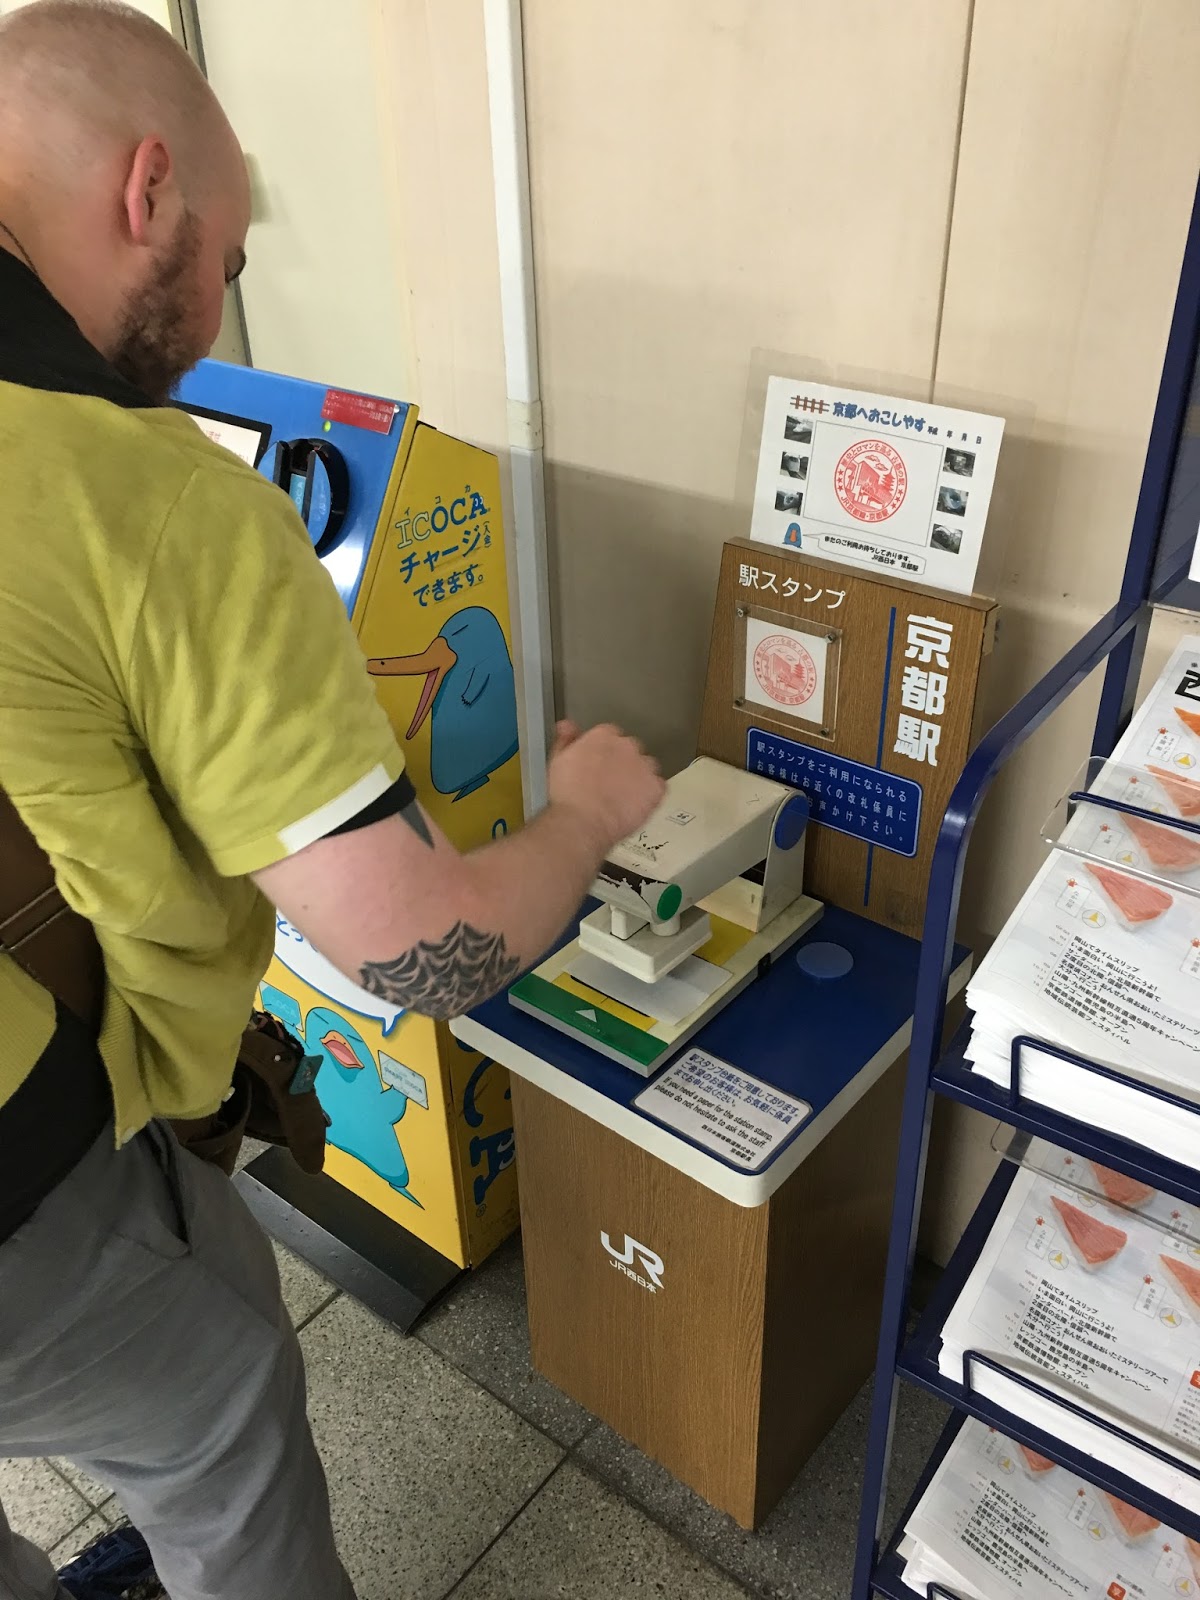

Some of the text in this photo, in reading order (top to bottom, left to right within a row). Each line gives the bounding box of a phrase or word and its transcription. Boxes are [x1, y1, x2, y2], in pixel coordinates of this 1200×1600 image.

[832, 401, 926, 432] 京都へおこしやす
[961, 432, 967, 442] 月
[976, 435, 982, 445] 日
[395, 492, 487, 549] ICOCA
[400, 525, 480, 584] チャージ
[413, 563, 484, 607] できます。
[739, 563, 847, 609] 駅スタンプ
[893, 614, 953, 767] 京都駅
[756, 740, 907, 803] 駅スタンプをご利用になられる
[757, 759, 907, 822] お客様はお近くの改札係員に
[654, 1084, 674, 1098] please
[674, 1094, 682, 1102] do
[682, 1099, 694, 1109] not
[693, 1104, 718, 1122] hesitate
[718, 1118, 725, 1126] to
[725, 1122, 737, 1134] ask
[737, 1128, 748, 1140] the
[669, 1079, 679, 1090] you
[680, 1085, 693, 1097] need
[697, 1095, 714, 1111] paper
[714, 1105, 724, 1114] for
[724, 1109, 734, 1119] the
[733, 1116, 755, 1131] station
[674, 1069, 736, 1107] までお申し出ください。
[681, 1062, 794, 1125] ご希望のお客様は、お気軽に係員
[689, 1053, 799, 1117] 駅スタンプ台紙をご用意しております。
[600, 1230, 664, 1290] JR
[609, 1260, 657, 1294] JR西日本
